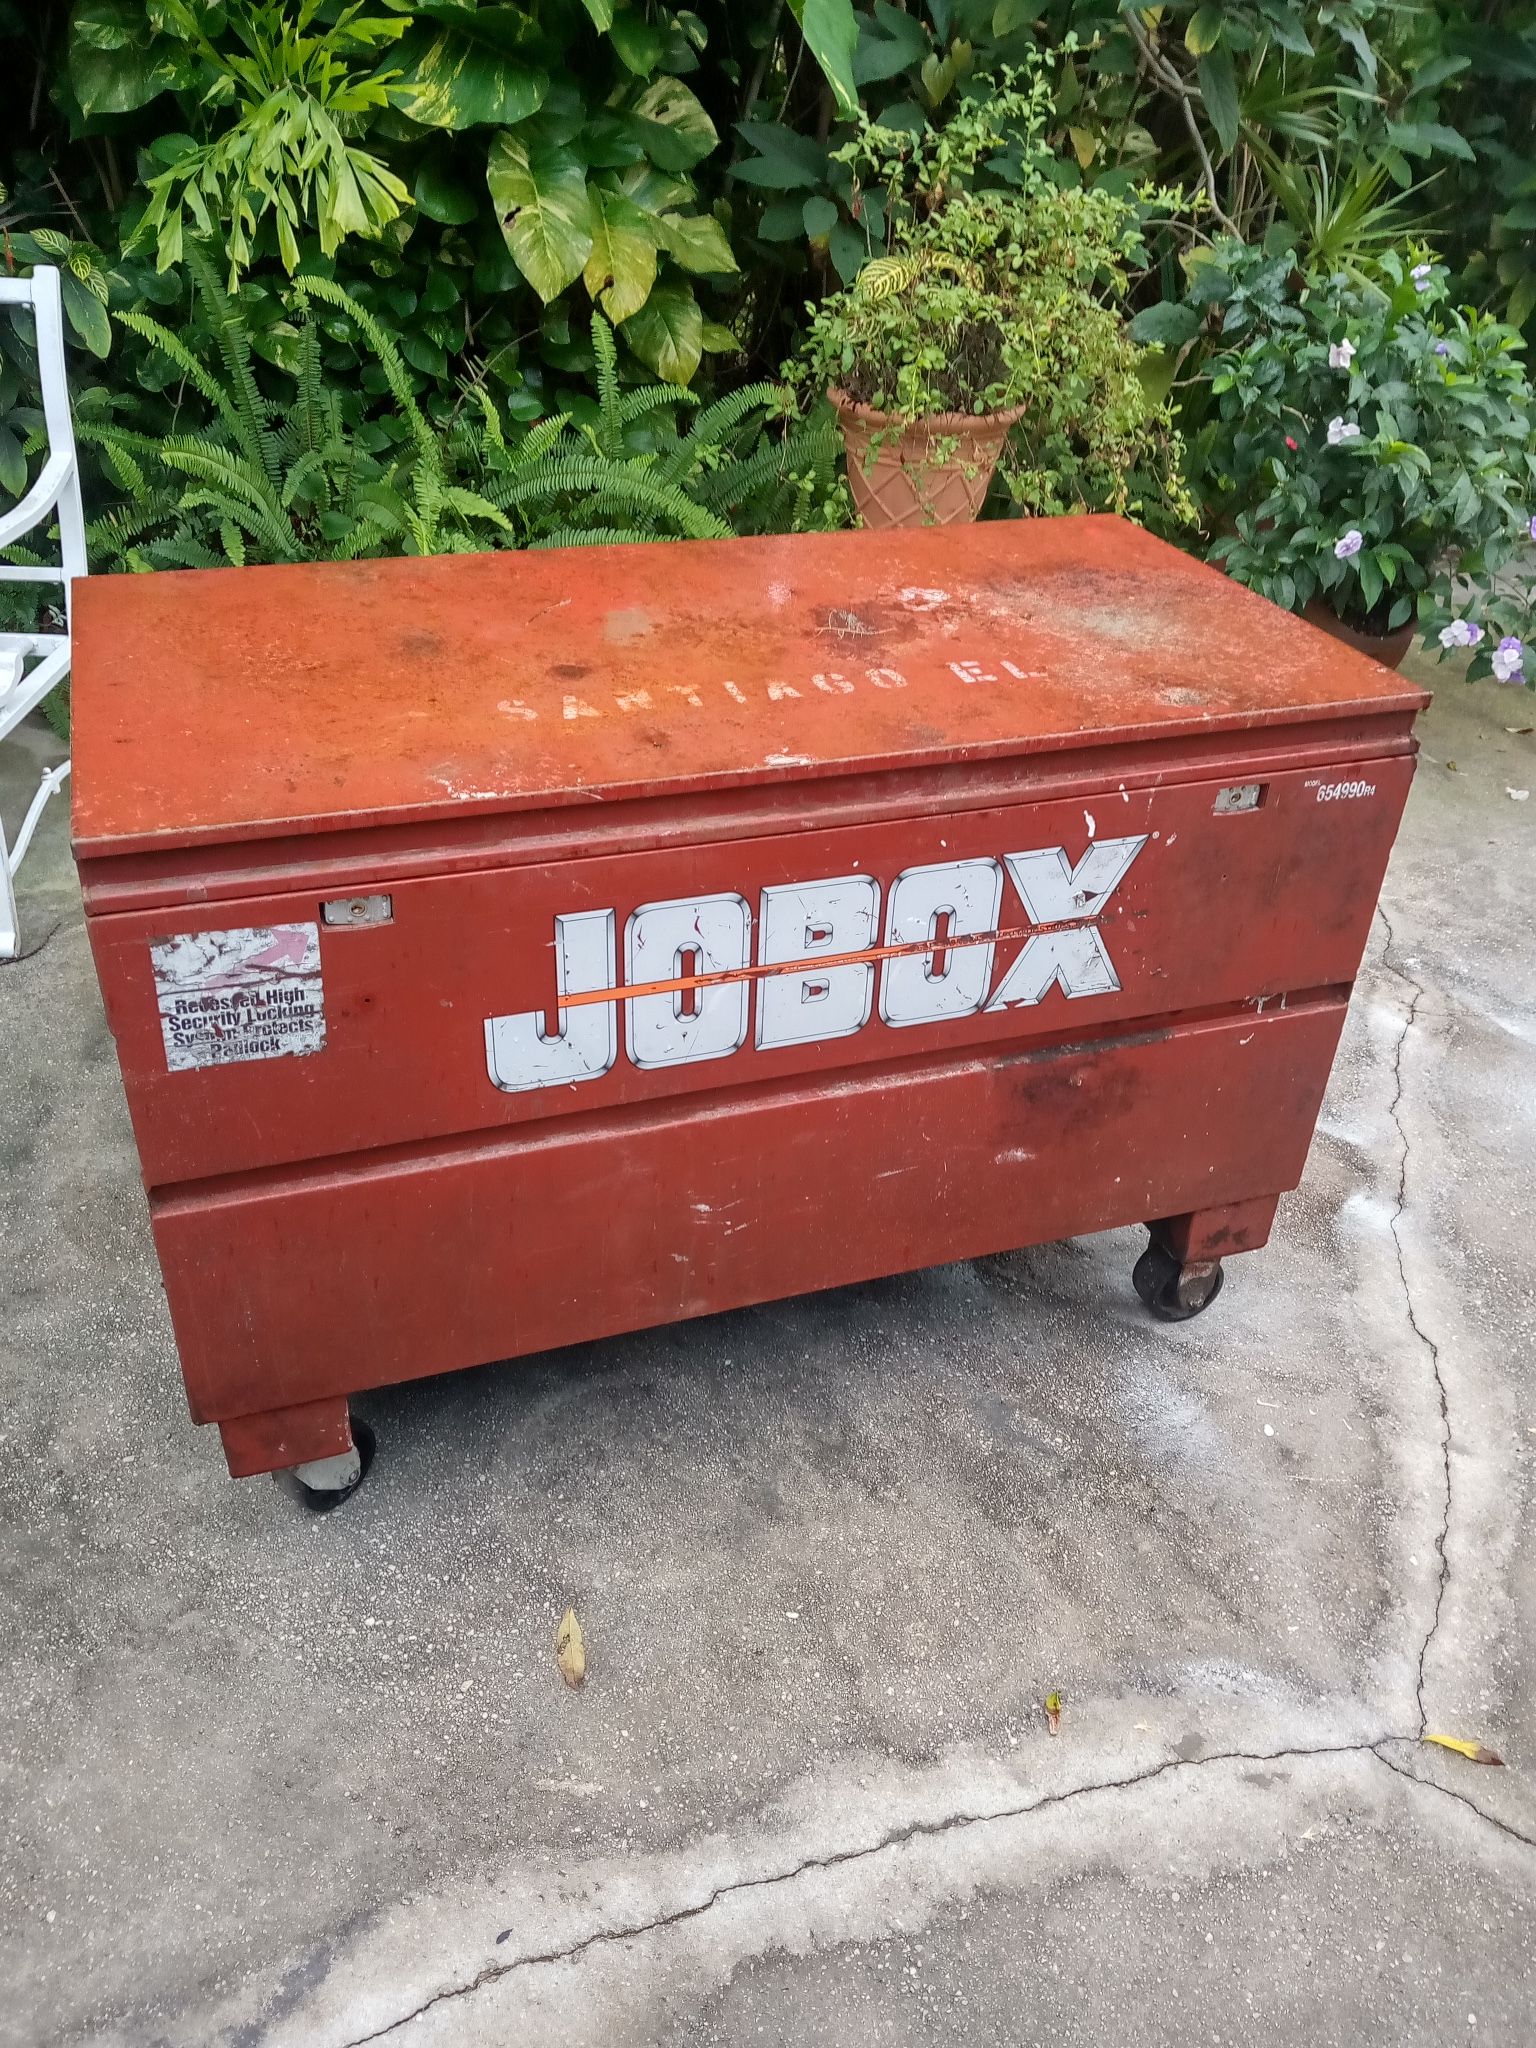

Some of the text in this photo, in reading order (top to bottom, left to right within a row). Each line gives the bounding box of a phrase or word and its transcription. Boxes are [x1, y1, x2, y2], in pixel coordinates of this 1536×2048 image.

[948, 659, 1048, 684] EL
[483, 833, 1151, 1094] JOBOX
[174, 987, 305, 1015] Reesed High
[168, 1003, 315, 1032] Security Locking
